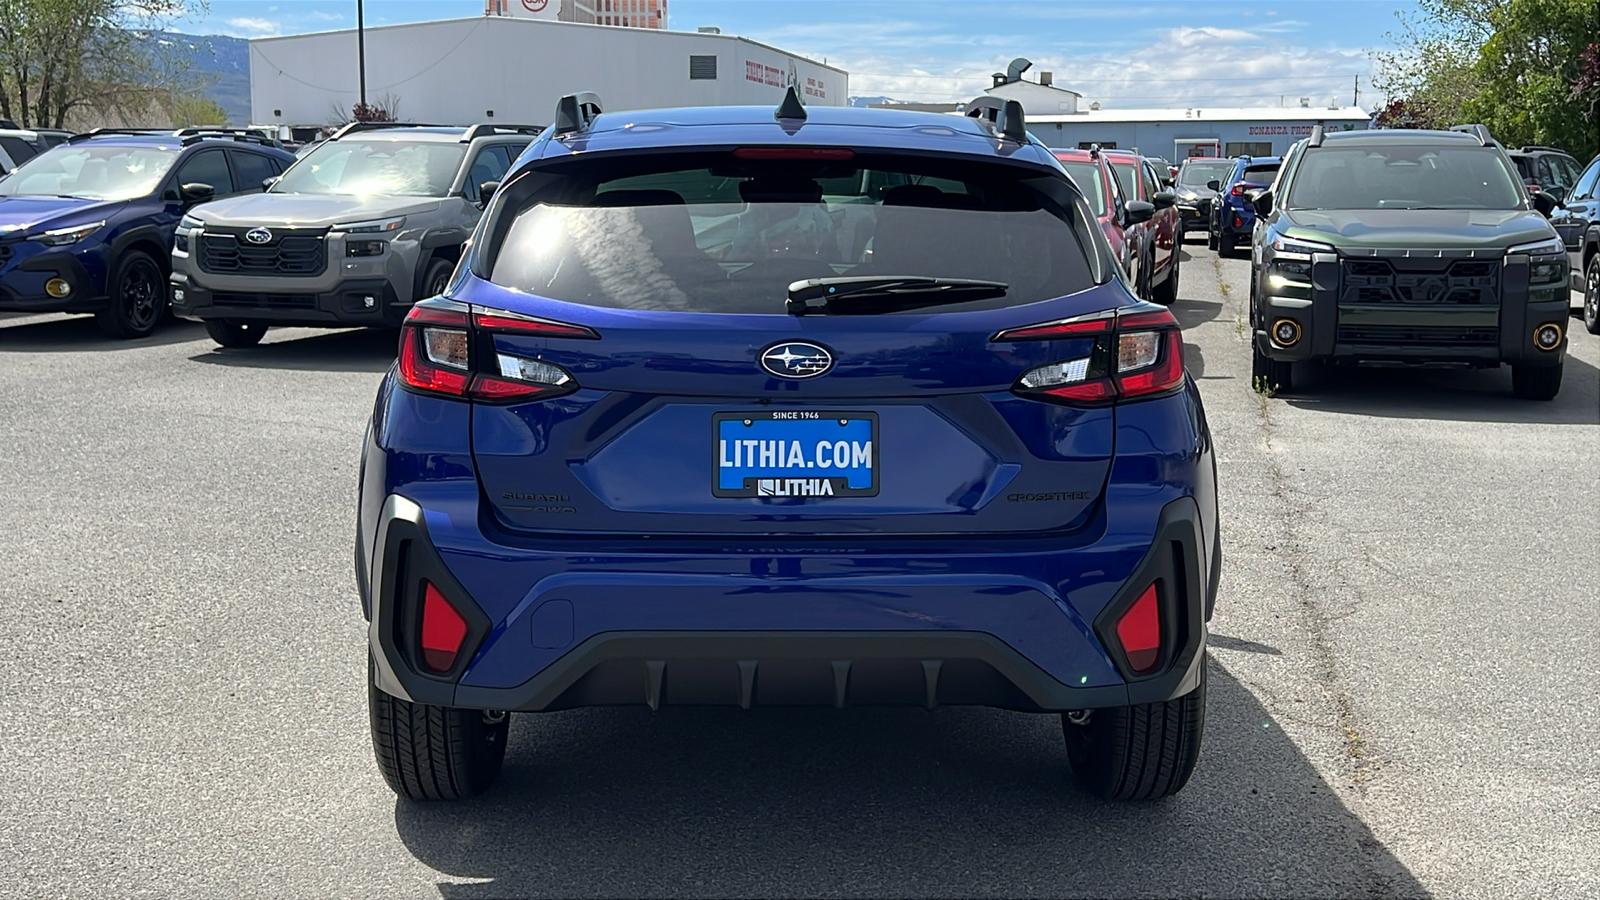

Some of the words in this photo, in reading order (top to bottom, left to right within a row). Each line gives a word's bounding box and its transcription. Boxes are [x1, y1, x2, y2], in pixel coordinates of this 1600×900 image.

[1249, 126, 1288, 135] BONANZA
[720, 440, 872, 469] LITHIA.COM
[775, 479, 833, 496] LITHIA
[502, 492, 571, 502] SUBARU
[1007, 490, 1092, 502] CROSSTREK
